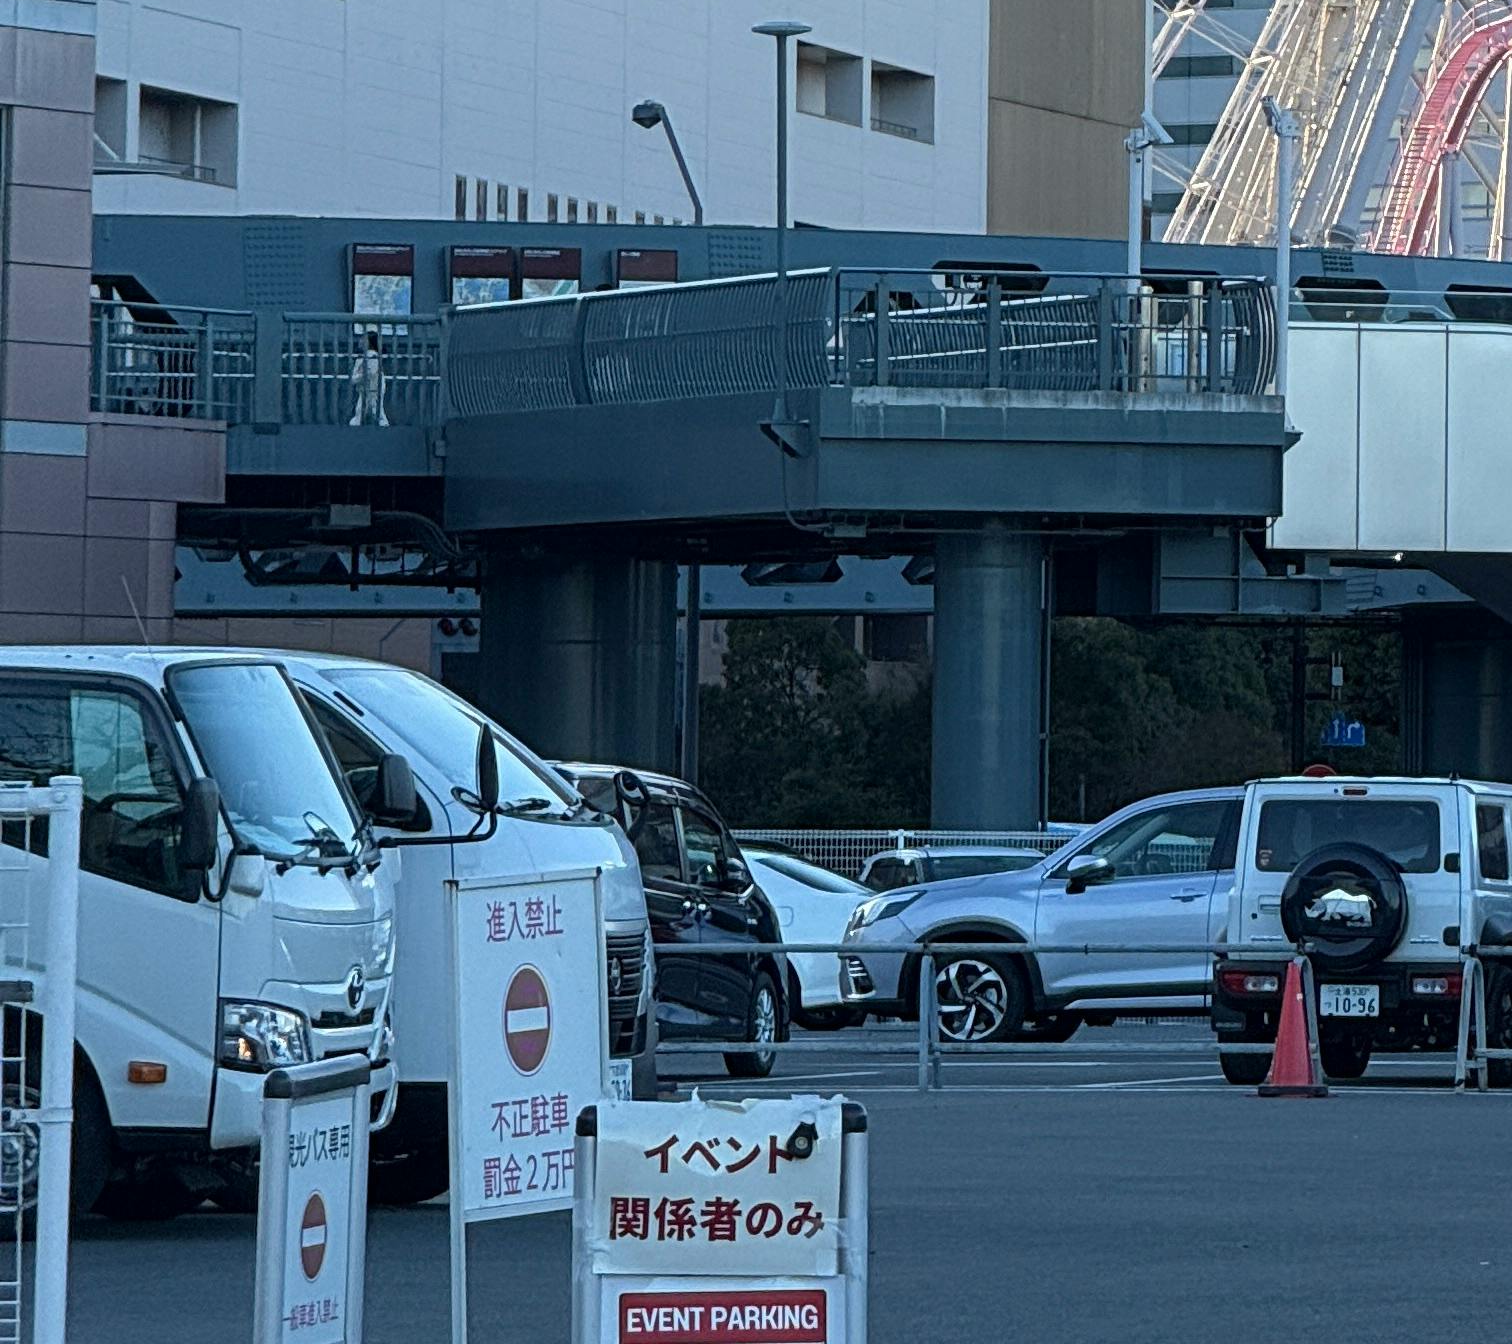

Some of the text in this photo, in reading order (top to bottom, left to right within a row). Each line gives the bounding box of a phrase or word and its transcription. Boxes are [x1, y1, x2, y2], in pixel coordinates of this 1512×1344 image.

[486, 894, 564, 943] 進入禁止
[1335, 996, 1376, 1014] 10-96
[491, 1092, 569, 1142] 不正駐車
[644, 1134, 794, 1174] イベント
[608, 1196, 825, 1242] 関係者のみ
[626, 1303, 819, 1333] EVENT PARKING
